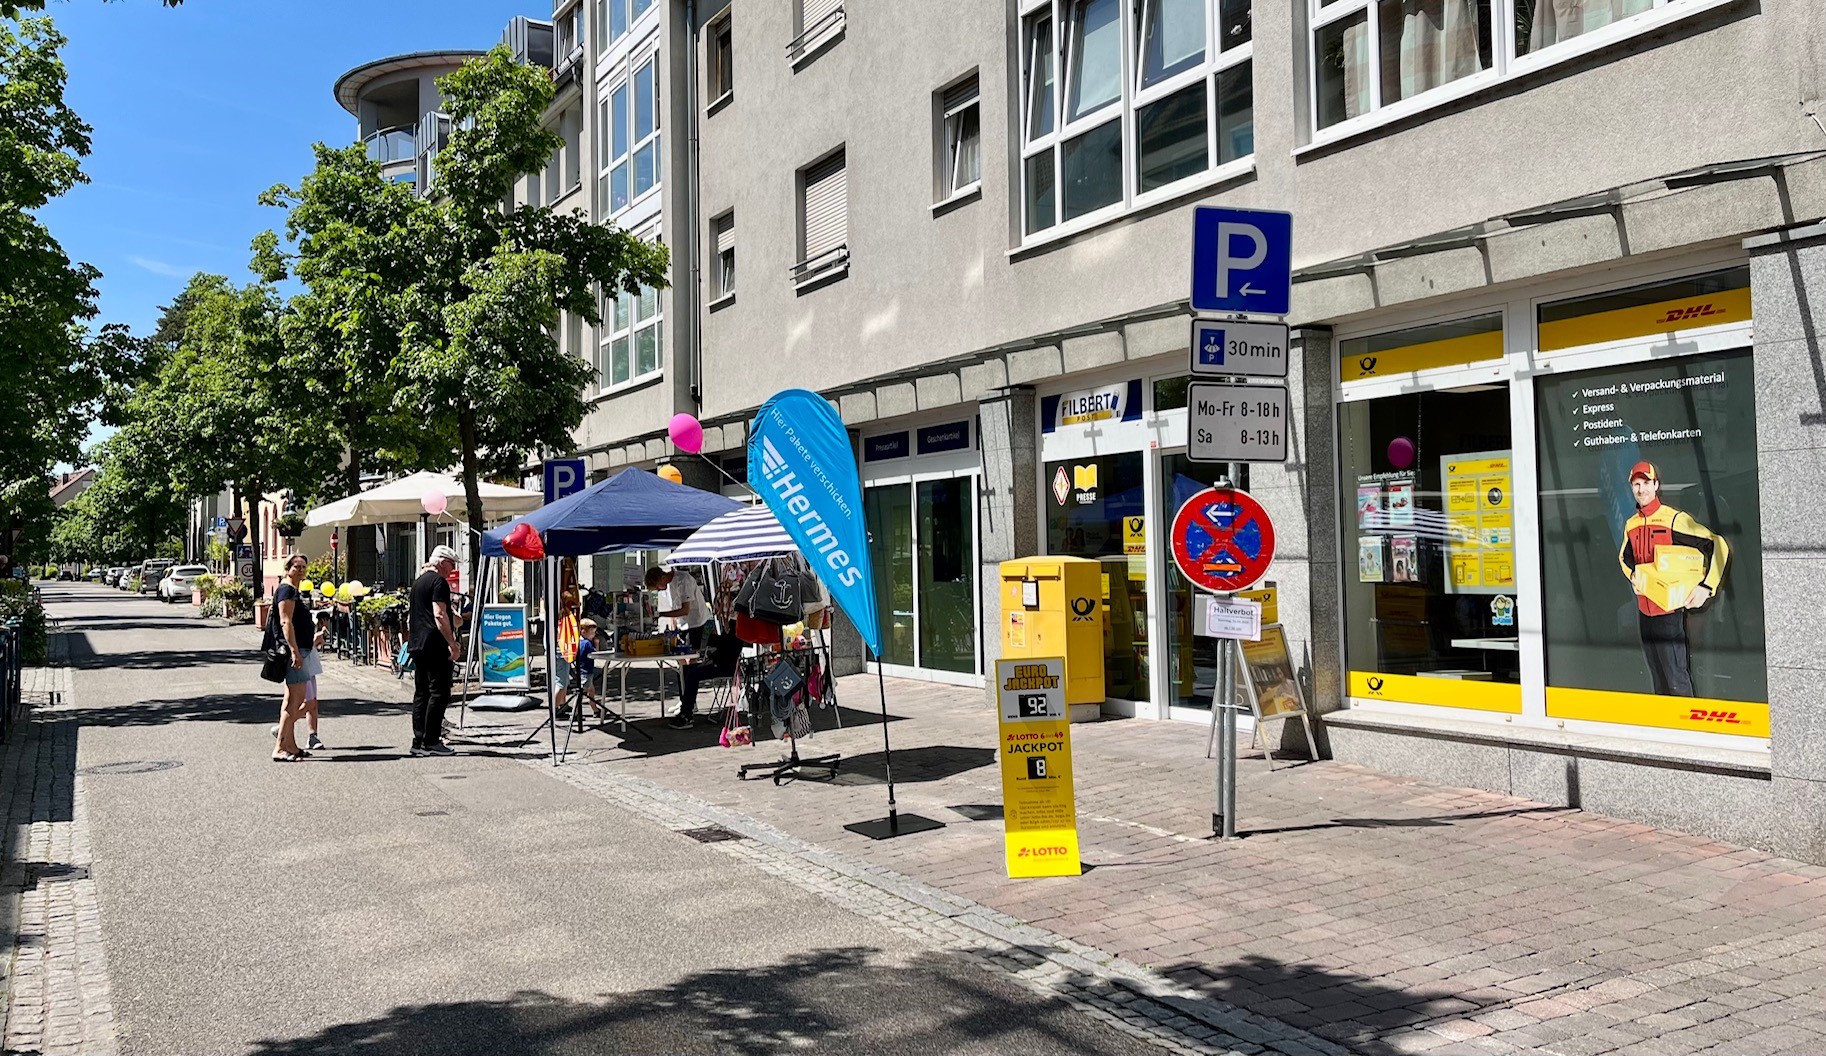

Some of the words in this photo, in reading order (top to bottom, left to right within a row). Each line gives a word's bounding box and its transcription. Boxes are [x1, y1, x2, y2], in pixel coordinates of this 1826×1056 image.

[1215, 221, 1268, 298] P
[1665, 303, 1716, 322] DHL
[1228, 340, 1247, 357] 30
[1250, 343, 1281, 358] min
[1582, 385, 1619, 399] Versand-
[1620, 383, 1629, 394] &
[1630, 371, 1725, 394] Verpackungsmaterial
[1062, 393, 1111, 417] FILBERT
[1197, 401, 1235, 418] Mo-Fr
[1582, 402, 1615, 416] Express
[1583, 418, 1623, 430] Postident
[1197, 429, 1213, 444] Sa
[1584, 434, 1629, 448] Guthaben-
[1630, 432, 1639, 442] &
[1640, 428, 1702, 442] Telefonkarten
[770, 406, 787, 430] Hier
[784, 426, 812, 464] Pakete
[808, 461, 852, 520] verschicken.
[554, 466, 576, 500] P
[1076, 492, 1096, 502] PRESSE
[772, 471, 863, 588] Hermes
[1669, 584, 1686, 607] M
[1214, 606, 1254, 616] Haltverbot
[1014, 664, 1048, 678] EURO
[1004, 676, 1060, 691] JACKPOT
[1028, 696, 1047, 714] 92
[1690, 709, 1740, 724] DHL
[1008, 742, 1064, 754] JACKPOT
[1036, 759, 1046, 776] 8
[1032, 846, 1068, 856] LOTTO
